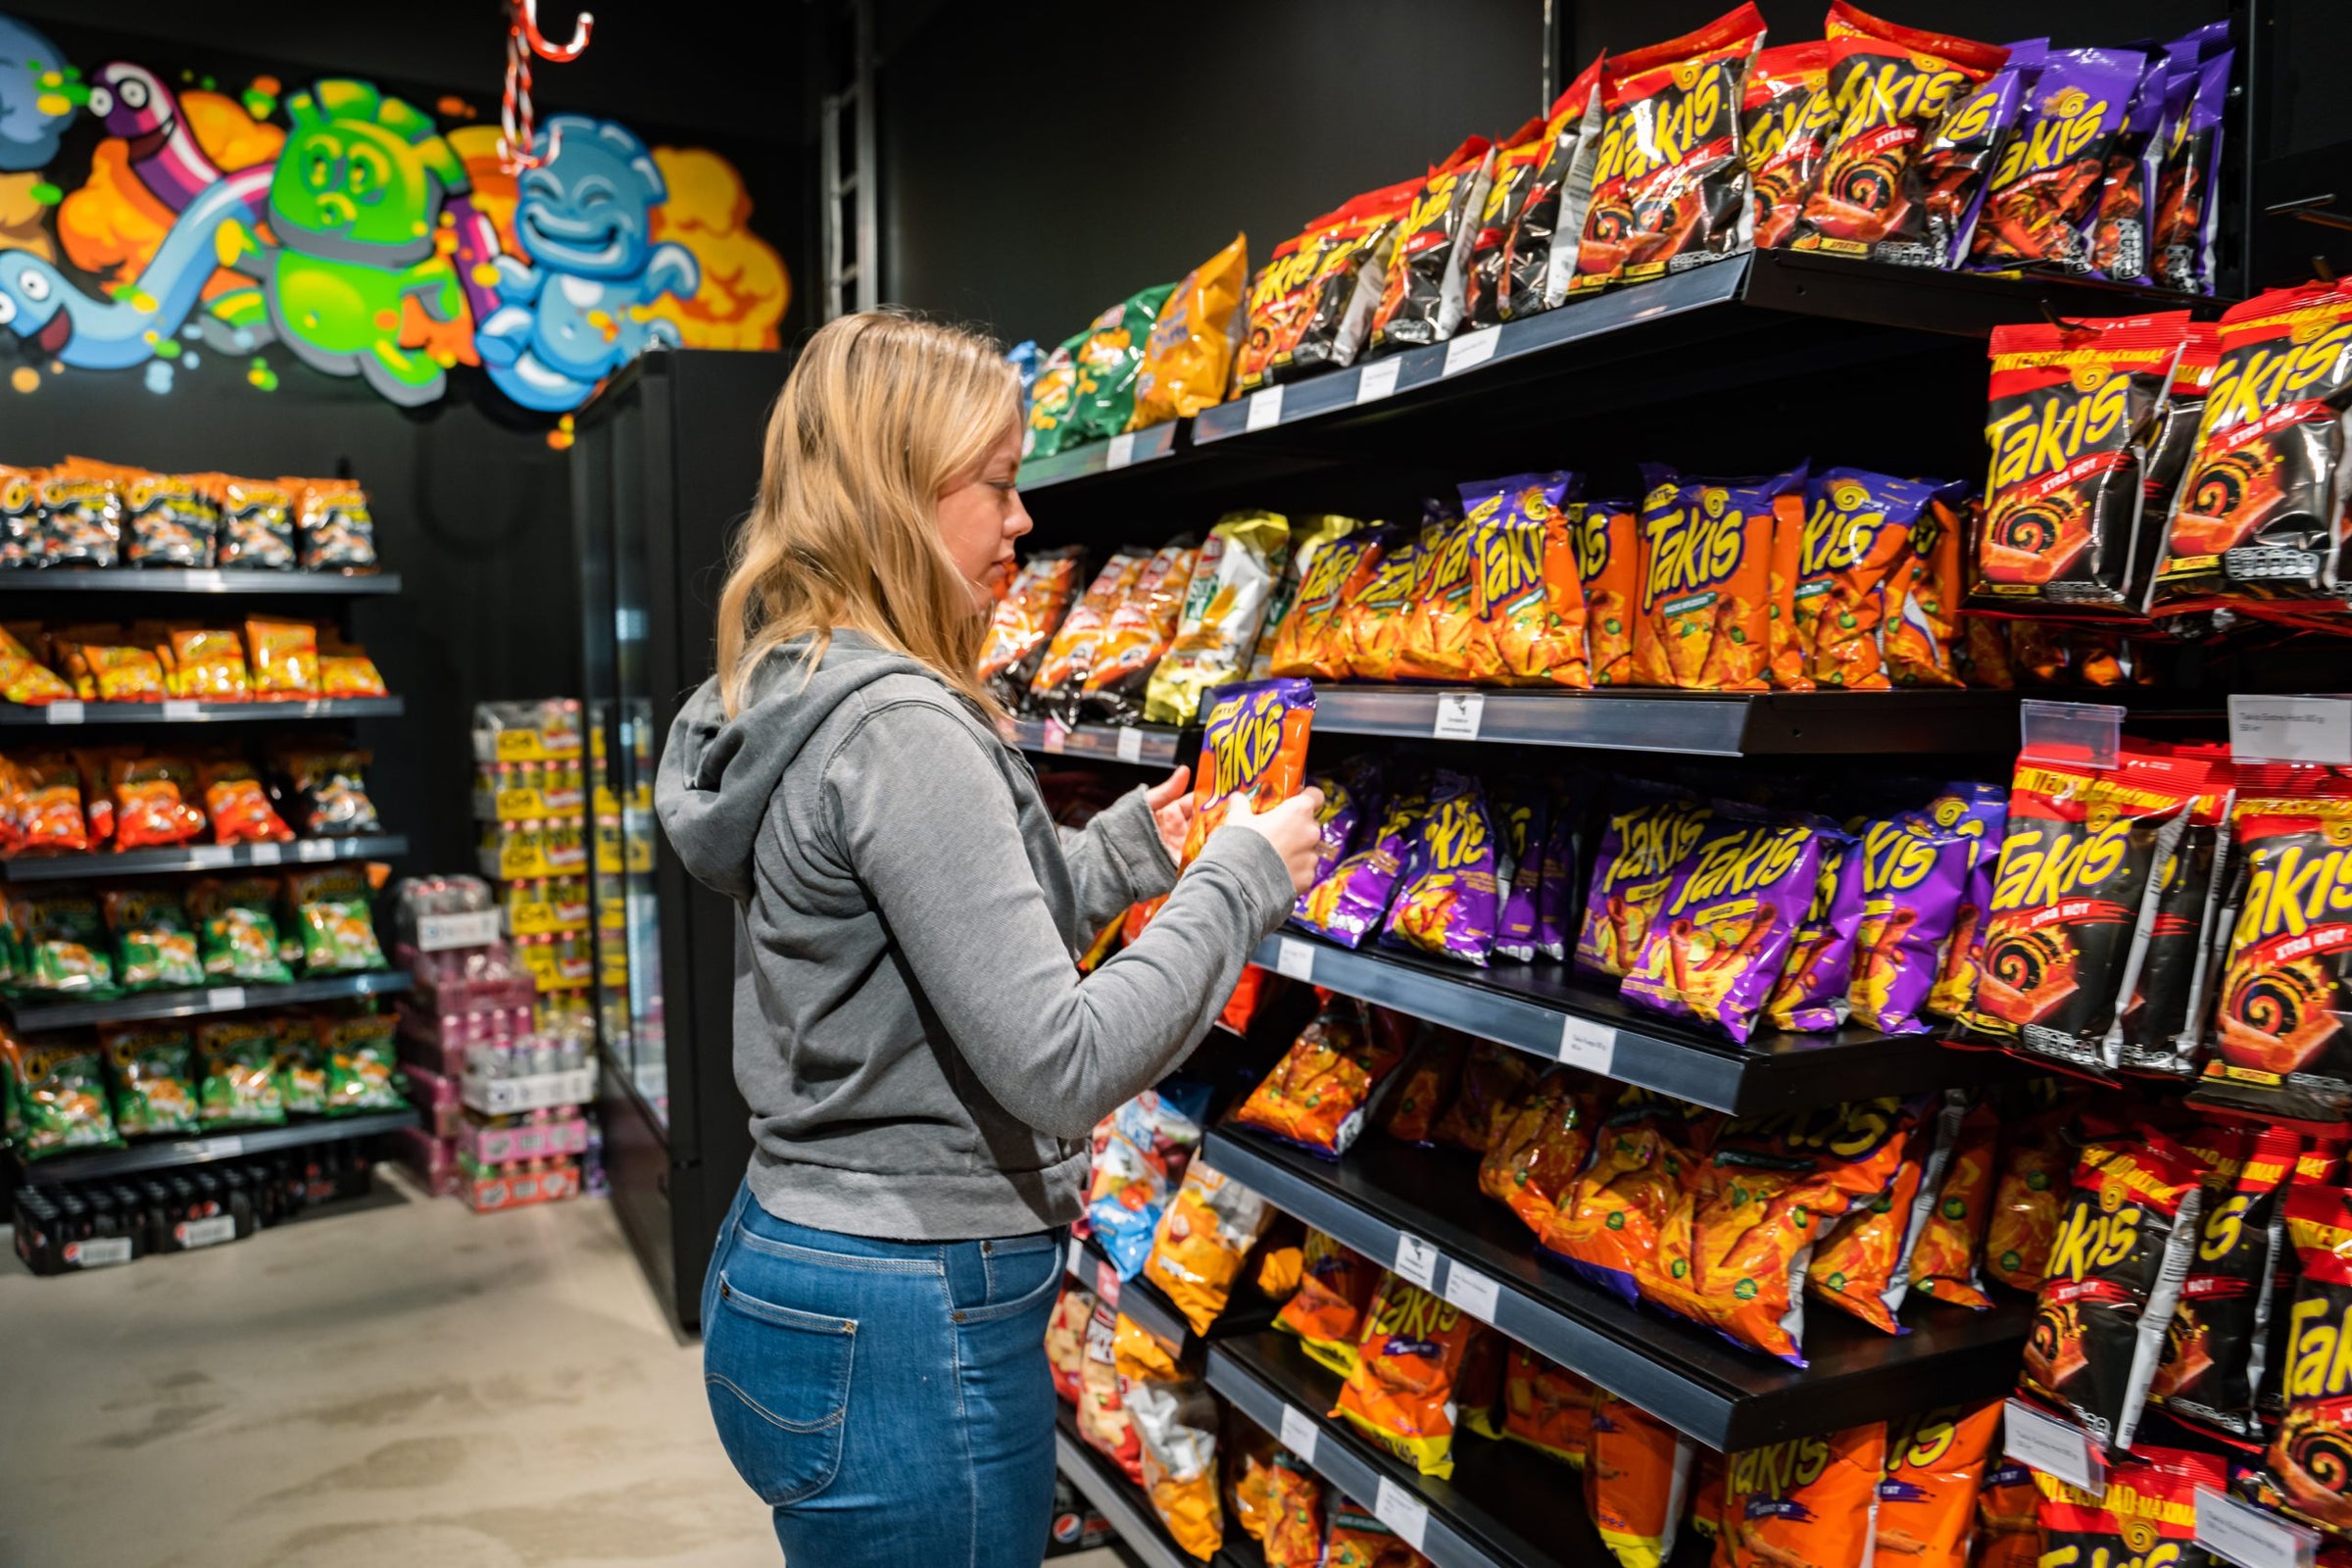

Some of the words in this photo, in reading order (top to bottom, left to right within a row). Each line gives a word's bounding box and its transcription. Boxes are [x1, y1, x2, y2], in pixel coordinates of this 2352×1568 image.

[1990, 101, 2107, 191] akis
[1984, 374, 2131, 511] Takis
[1473, 513, 1546, 619] Taki
[1643, 507, 1743, 610] Takis
[1203, 703, 1284, 810] Takis
[1604, 804, 1713, 894] Takis
[1668, 827, 1813, 916] Takis
[1990, 819, 2132, 910] Takis
[2313, 928, 2347, 947] HOT
